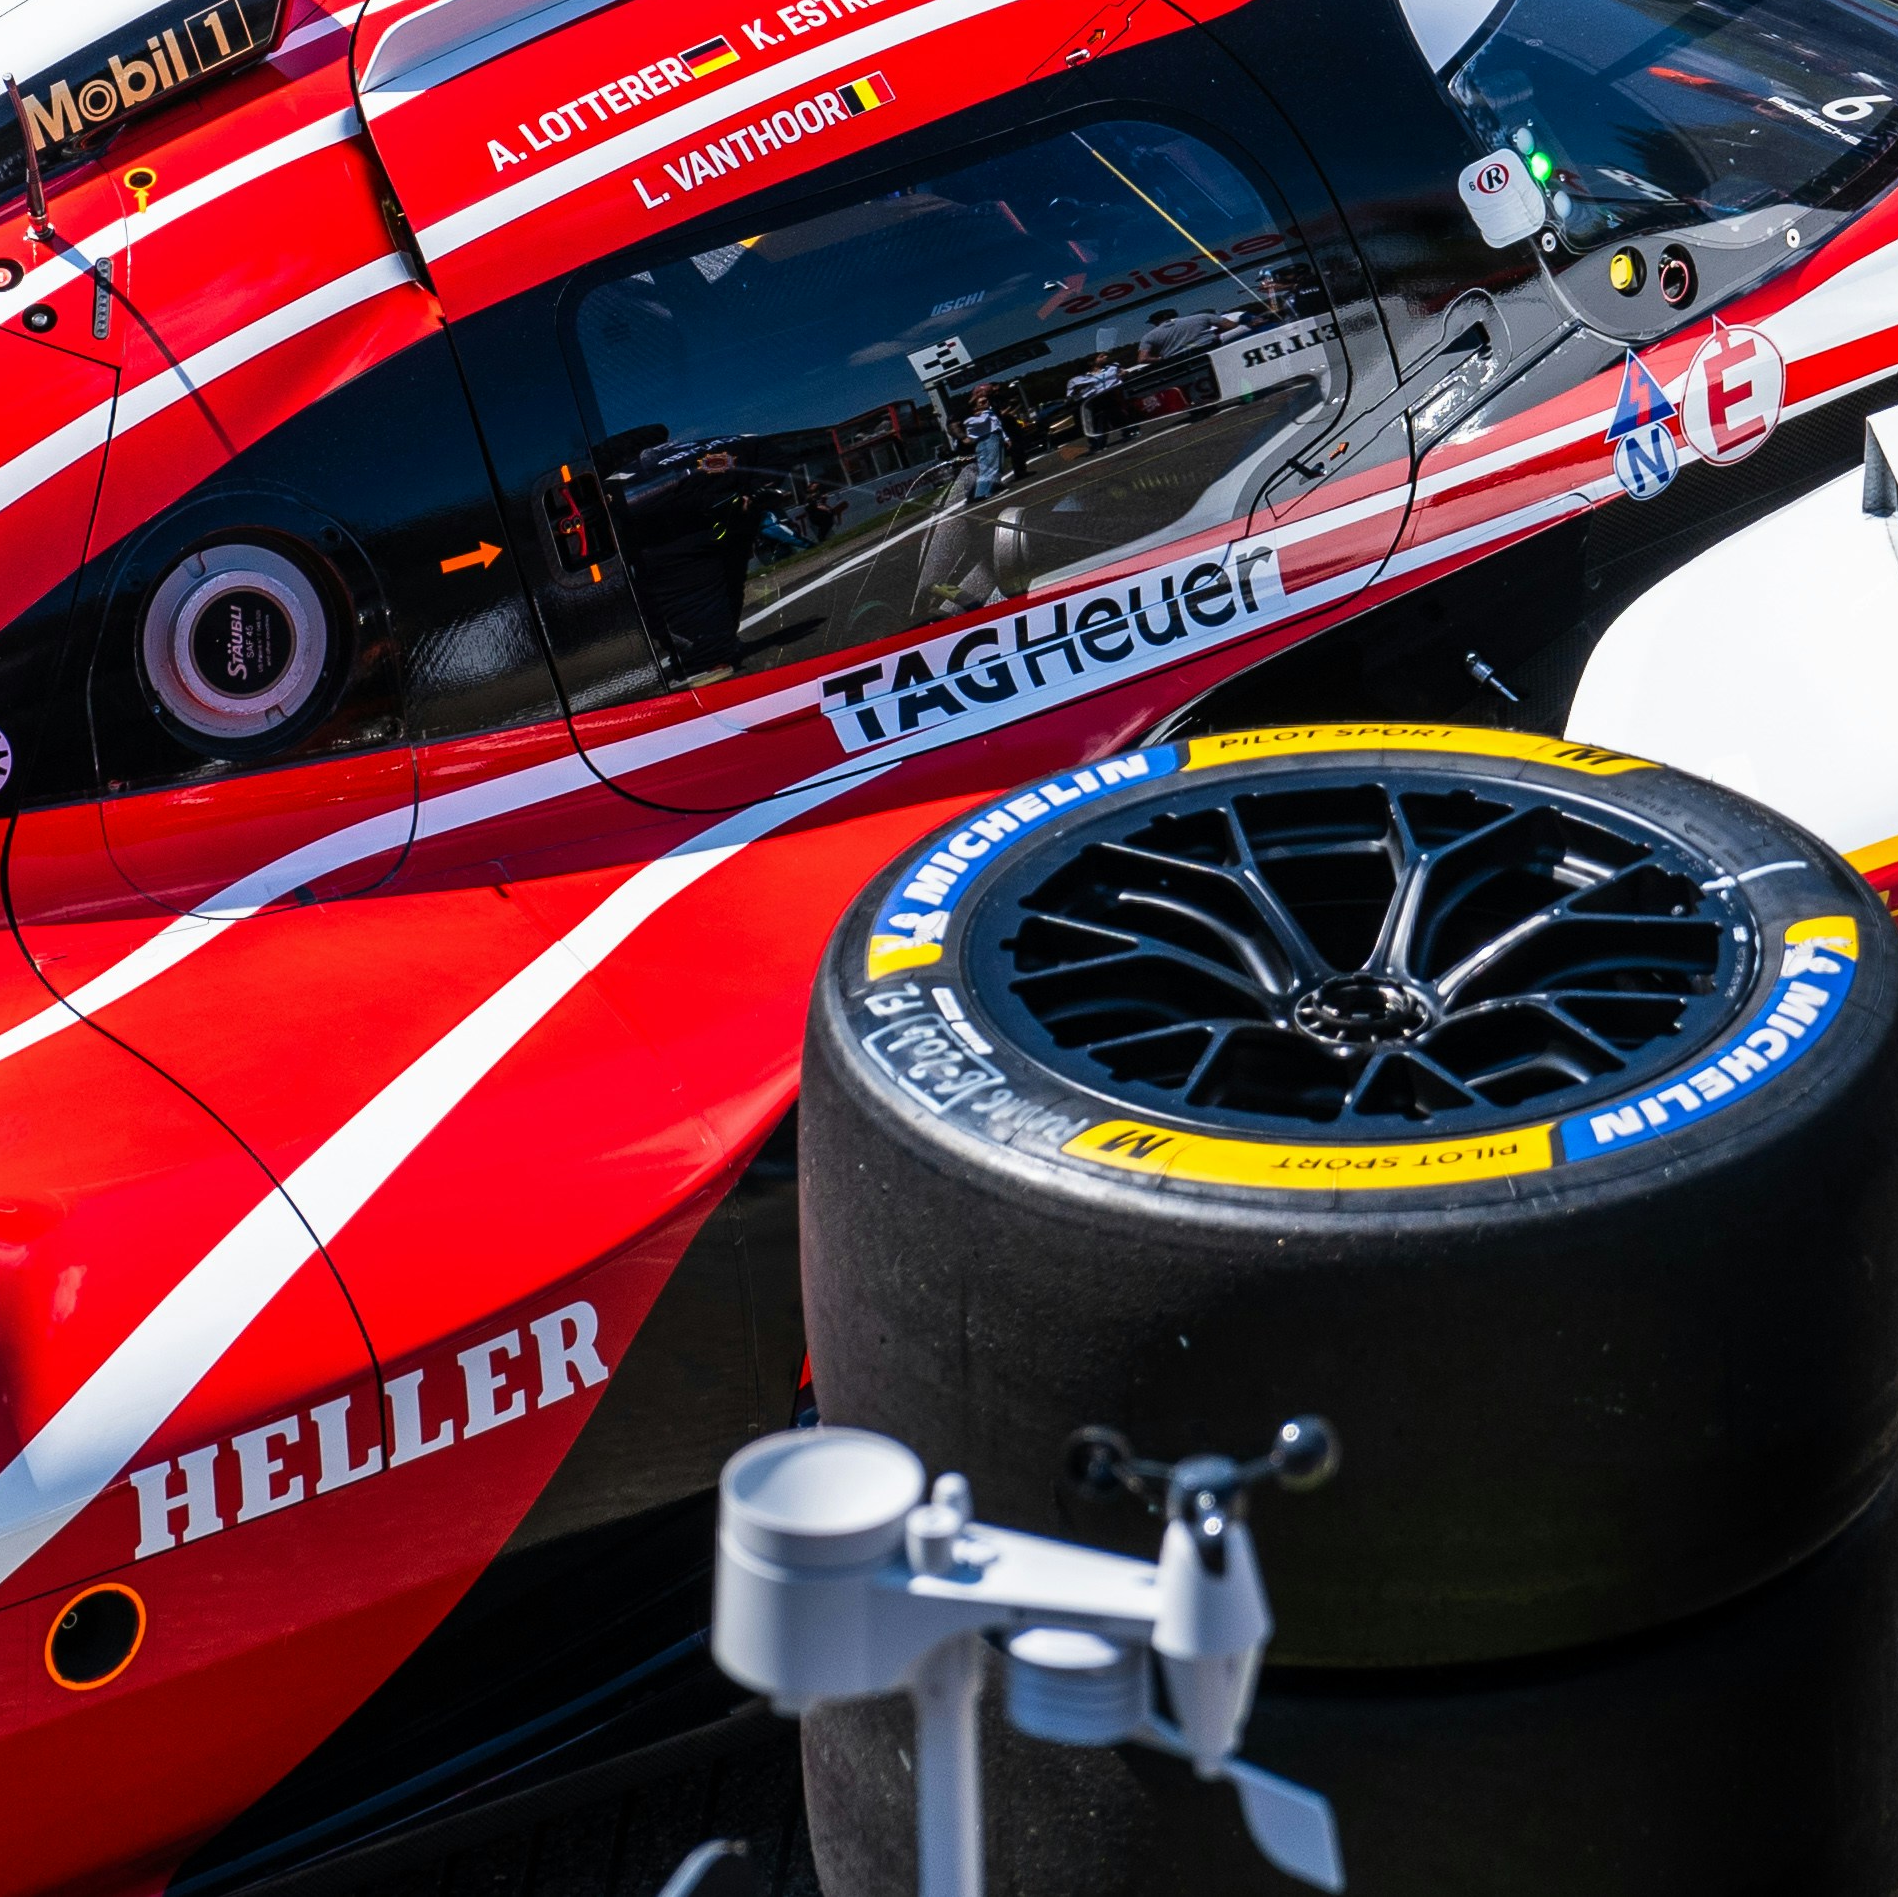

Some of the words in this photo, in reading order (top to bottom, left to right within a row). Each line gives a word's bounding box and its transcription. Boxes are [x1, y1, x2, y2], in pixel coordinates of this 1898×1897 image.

[23, 27, 189, 152] Mobil
[203, 9, 226, 56] 1
[485, 139, 527, 173] A.
[518, 56, 691, 159] LOTTERER
[740, 12, 783, 52] K.
[1768, 96, 1862, 147] PORSCHE
[1822, 94, 1895, 122] 6
[633, 176, 671, 211] L.
[665, 88, 847, 194] VANTHOOR
[1703, 335, 1767, 456] E
[1624, 435, 1672, 494] N
[1218, 727, 1317, 751] PILOT
[1334, 725, 1454, 740] SPORT
[1554, 744, 1629, 768] M
[903, 752, 1151, 908] MICHELIN
[1589, 977, 1833, 1146] MICHELIN
[1102, 1128, 1177, 1160] M
[1271, 1154, 1401, 1173] SPORT
[1411, 1140, 1520, 1167] PILOT
[126, 1298, 611, 1562] HELLER
